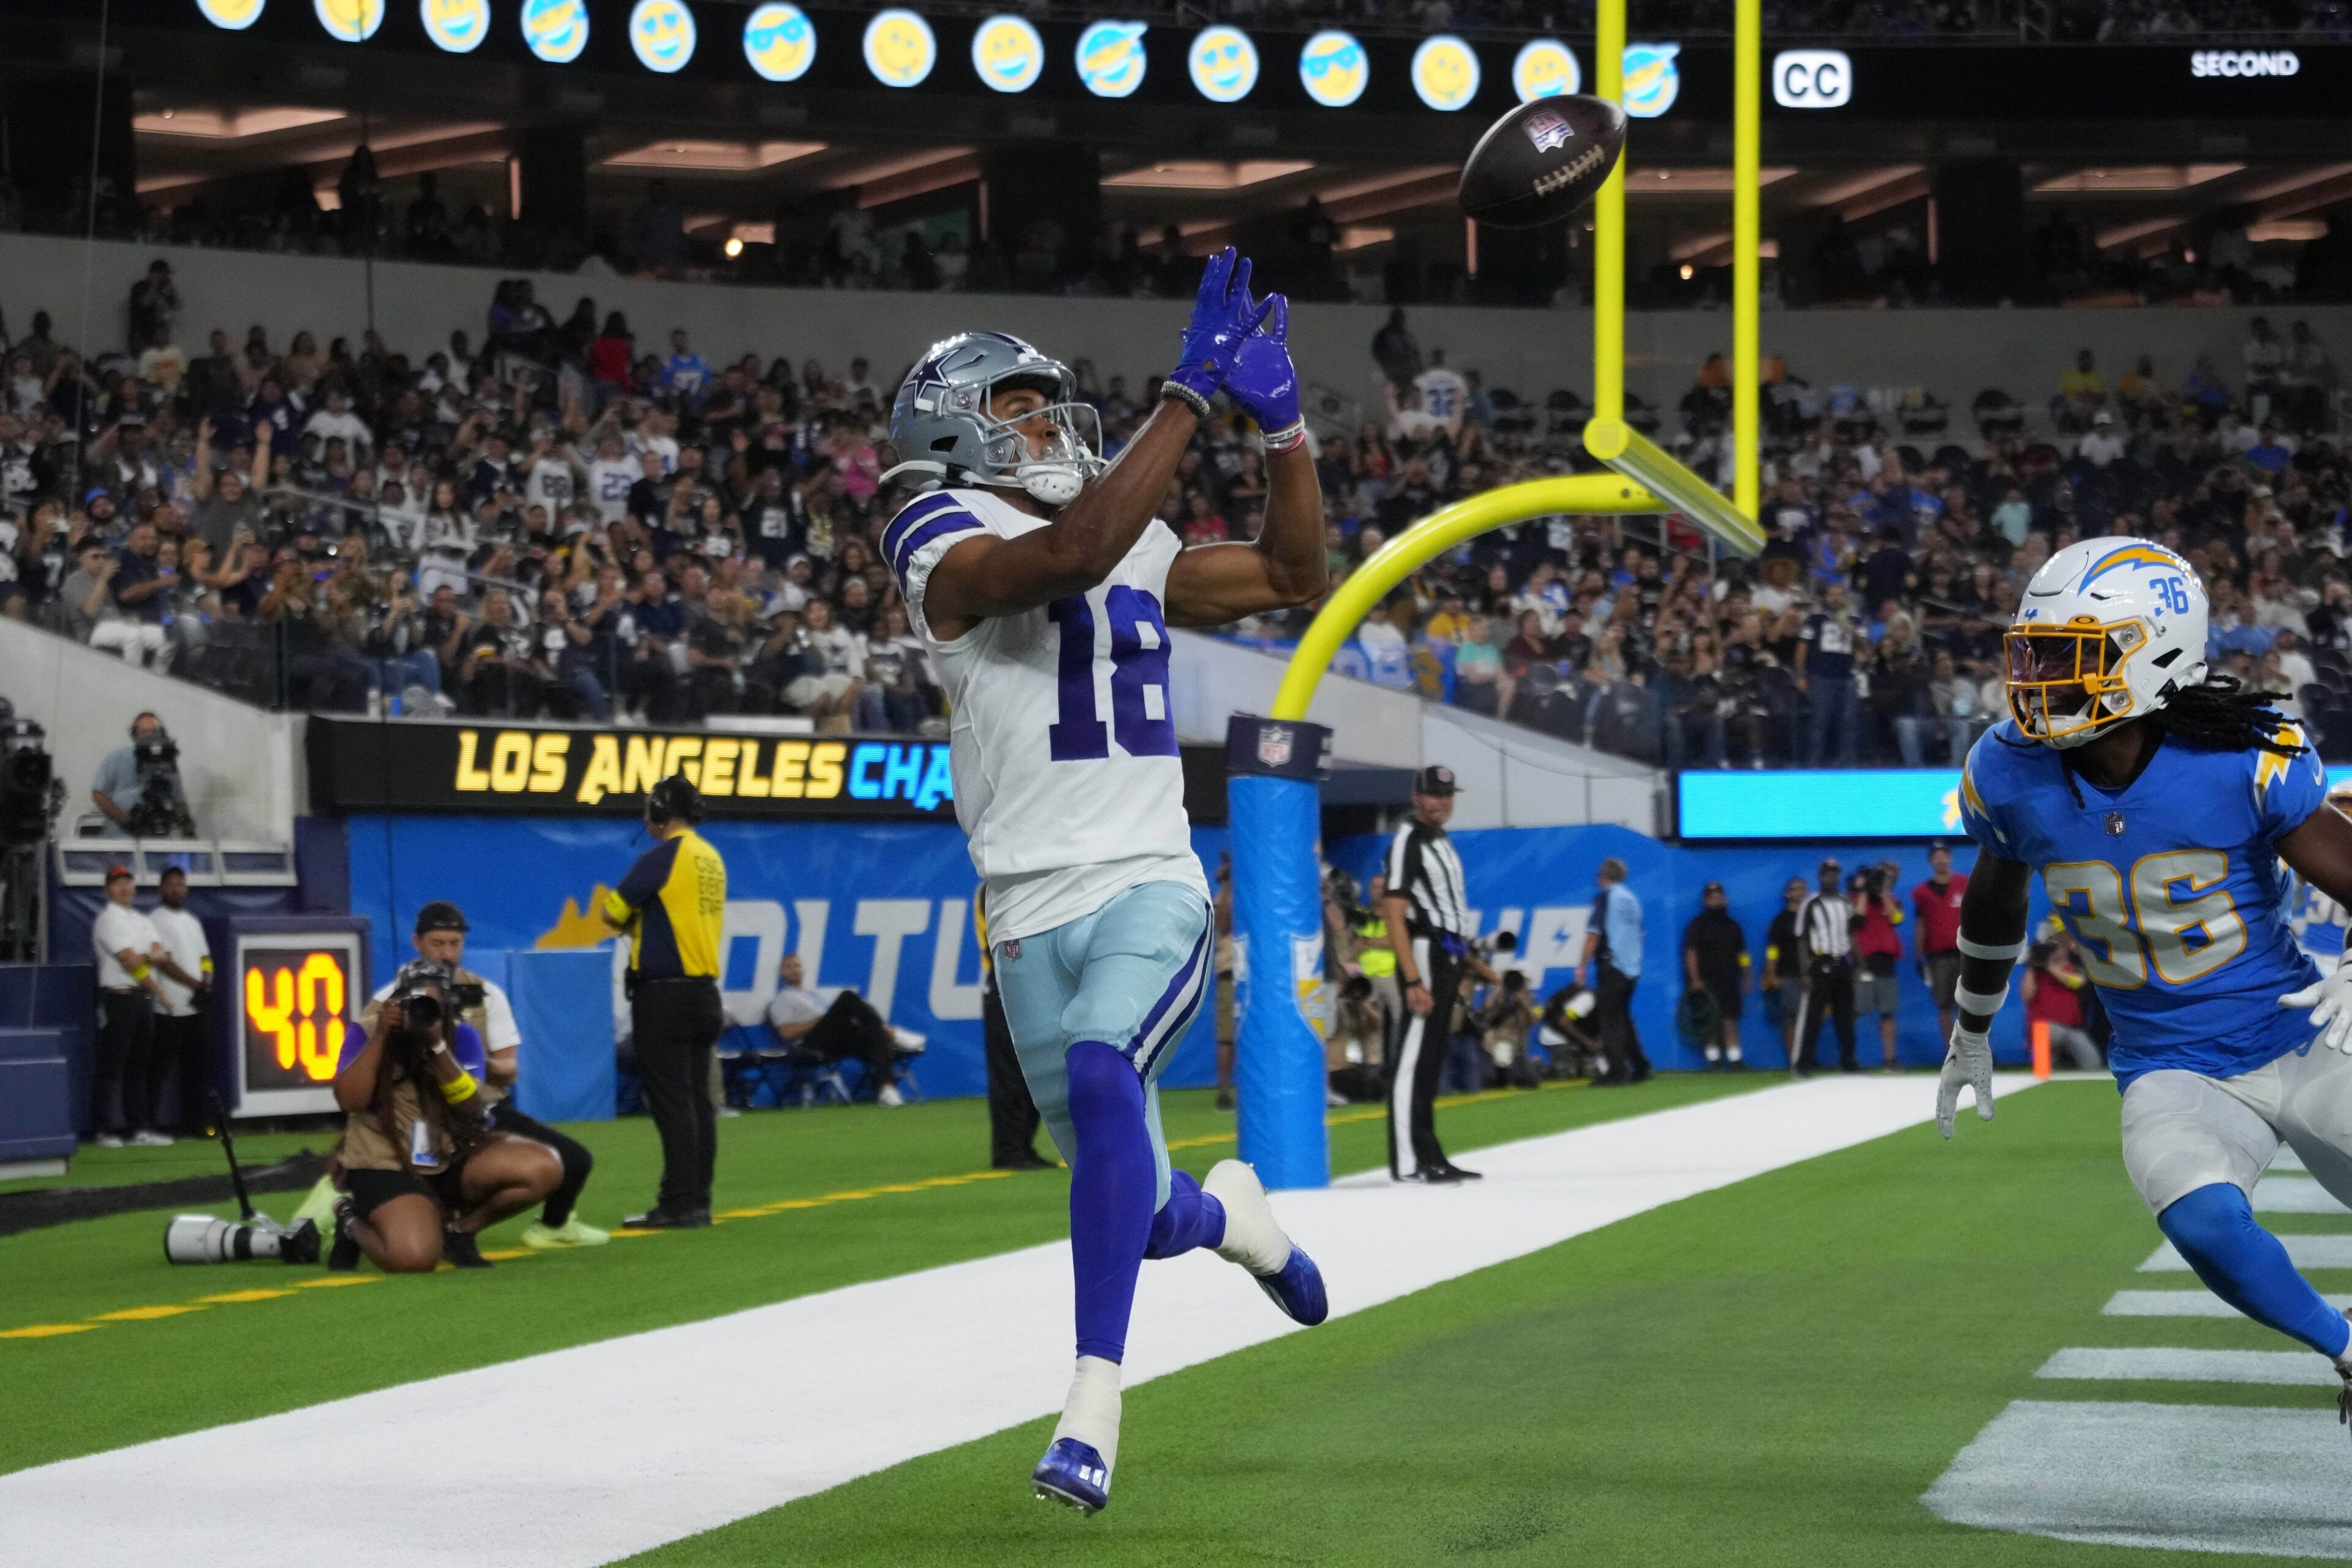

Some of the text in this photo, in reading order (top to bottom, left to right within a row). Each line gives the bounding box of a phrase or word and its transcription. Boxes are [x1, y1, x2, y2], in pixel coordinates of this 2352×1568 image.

[1782, 62, 1840, 99] CC
[2191, 51, 2300, 77] SECOND
[2149, 576, 2189, 617] 36
[1047, 585, 1181, 761] 18
[455, 729, 570, 793] LOS
[576, 734, 848, 805] ANGELES
[2044, 848, 2247, 990] 36
[245, 952, 345, 1080] 40
